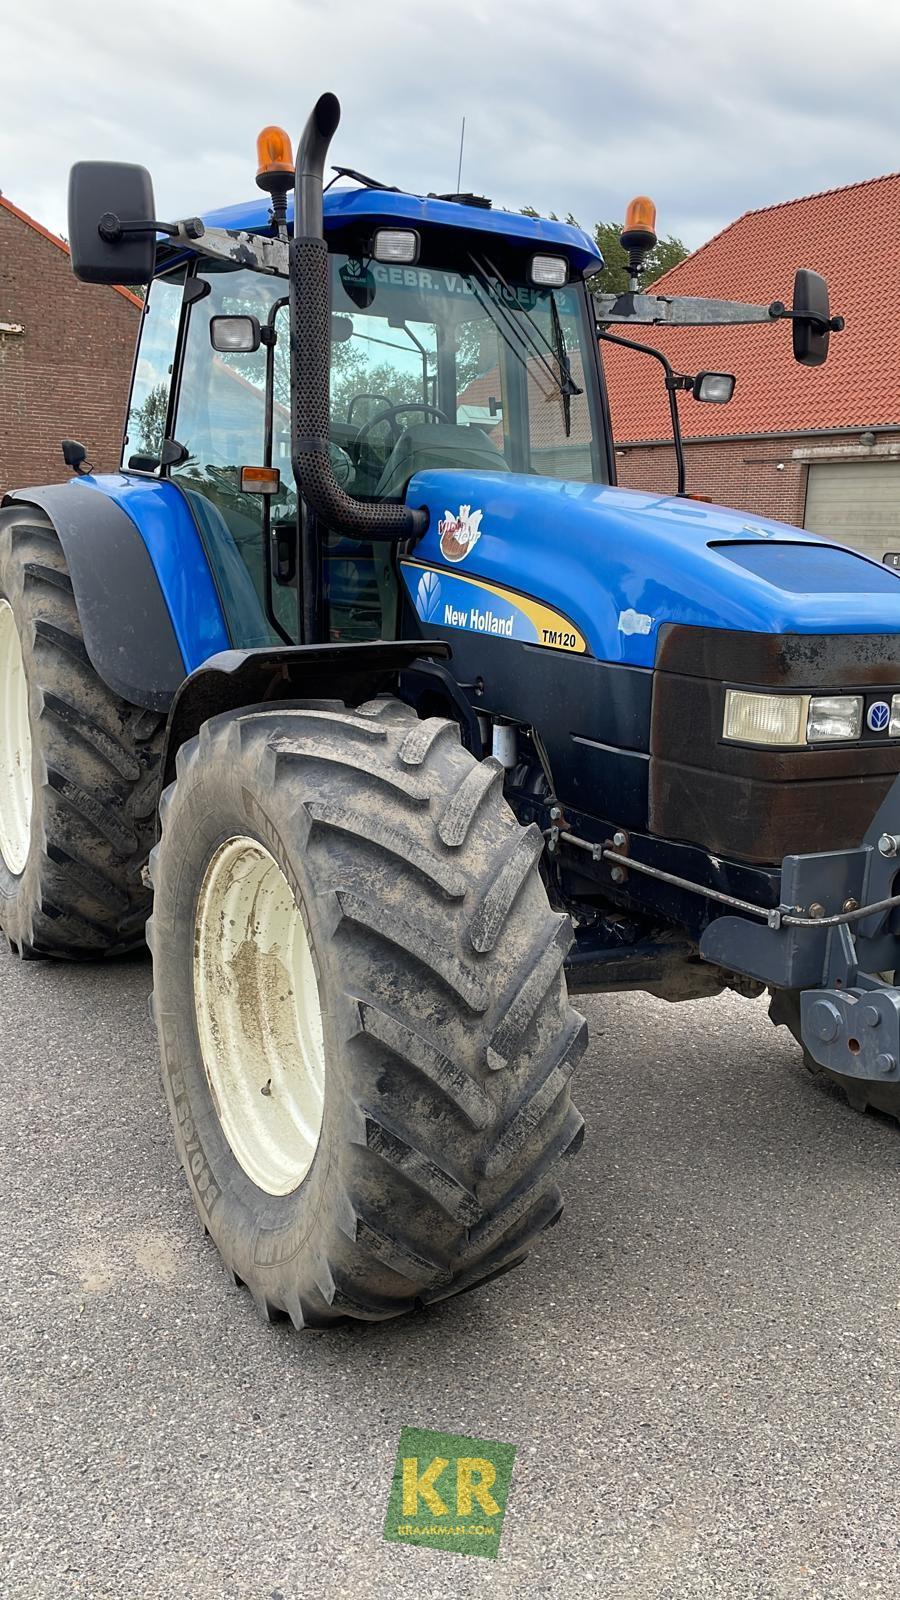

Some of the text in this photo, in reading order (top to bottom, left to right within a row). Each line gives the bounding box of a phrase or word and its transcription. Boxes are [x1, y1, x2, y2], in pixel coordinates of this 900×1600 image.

[372, 265, 440, 290] GEBR.
[444, 604, 514, 636] New Holland
[542, 629, 577, 648] TM120
